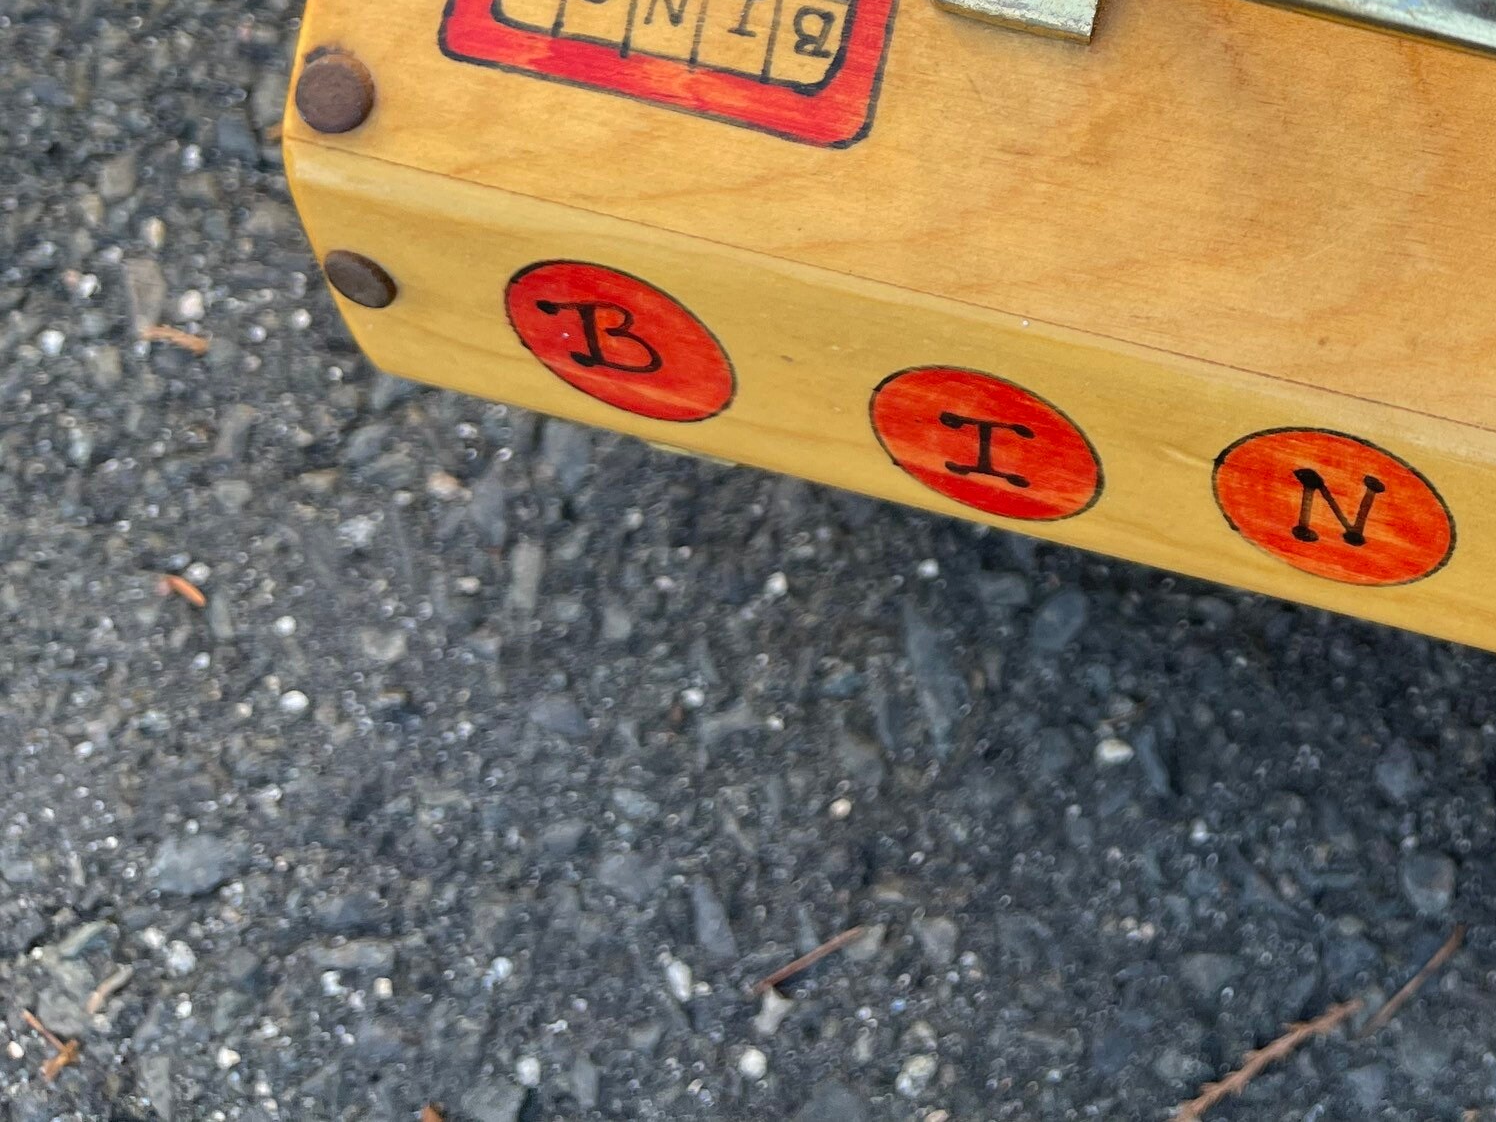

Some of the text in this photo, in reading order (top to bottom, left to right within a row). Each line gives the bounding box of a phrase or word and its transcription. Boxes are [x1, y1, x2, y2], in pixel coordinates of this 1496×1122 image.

[792, 6, 835, 58] B
[536, 299, 662, 374] B
[938, 411, 1036, 489] I
[1290, 468, 1385, 544] N
